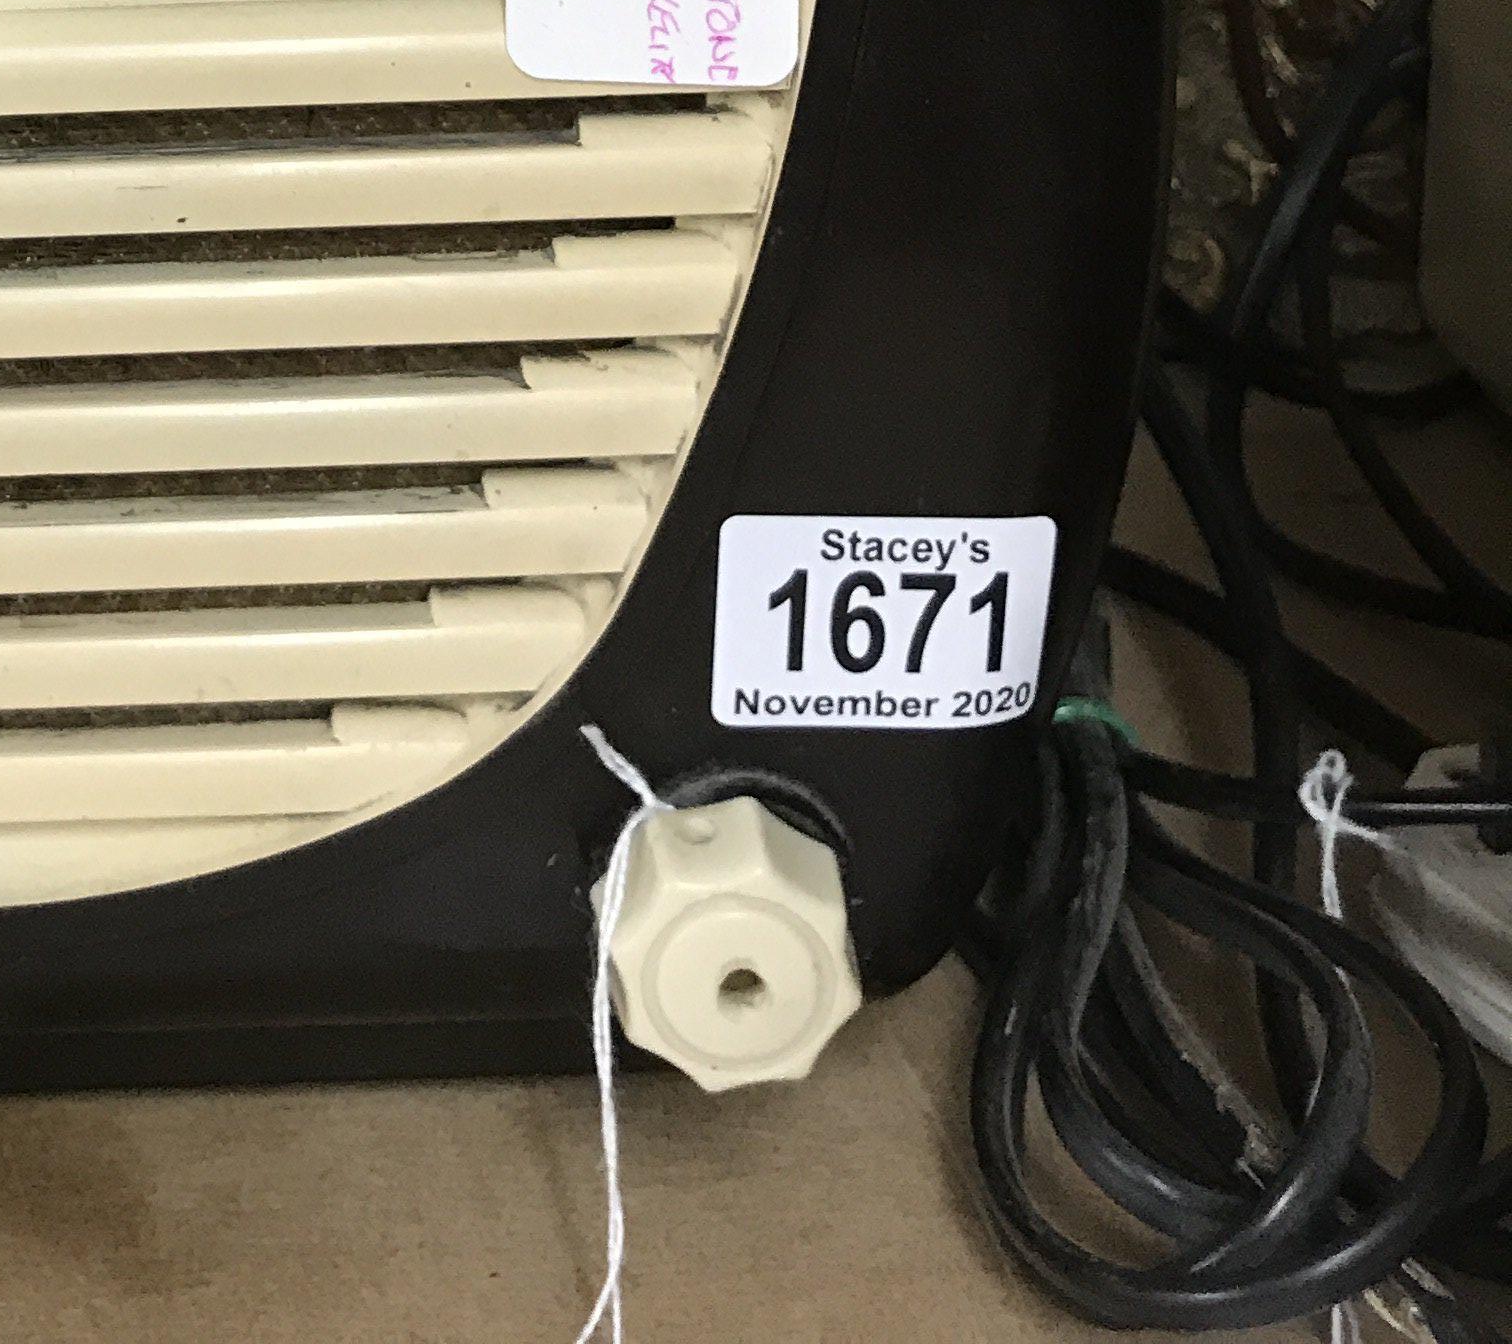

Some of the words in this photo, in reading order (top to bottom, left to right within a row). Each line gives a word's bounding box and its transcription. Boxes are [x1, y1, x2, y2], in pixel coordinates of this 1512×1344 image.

[820, 528, 991, 572] Stacey's
[768, 568, 1009, 673] 1671
[734, 688, 940, 719] November
[952, 682, 1032, 718] 2020
